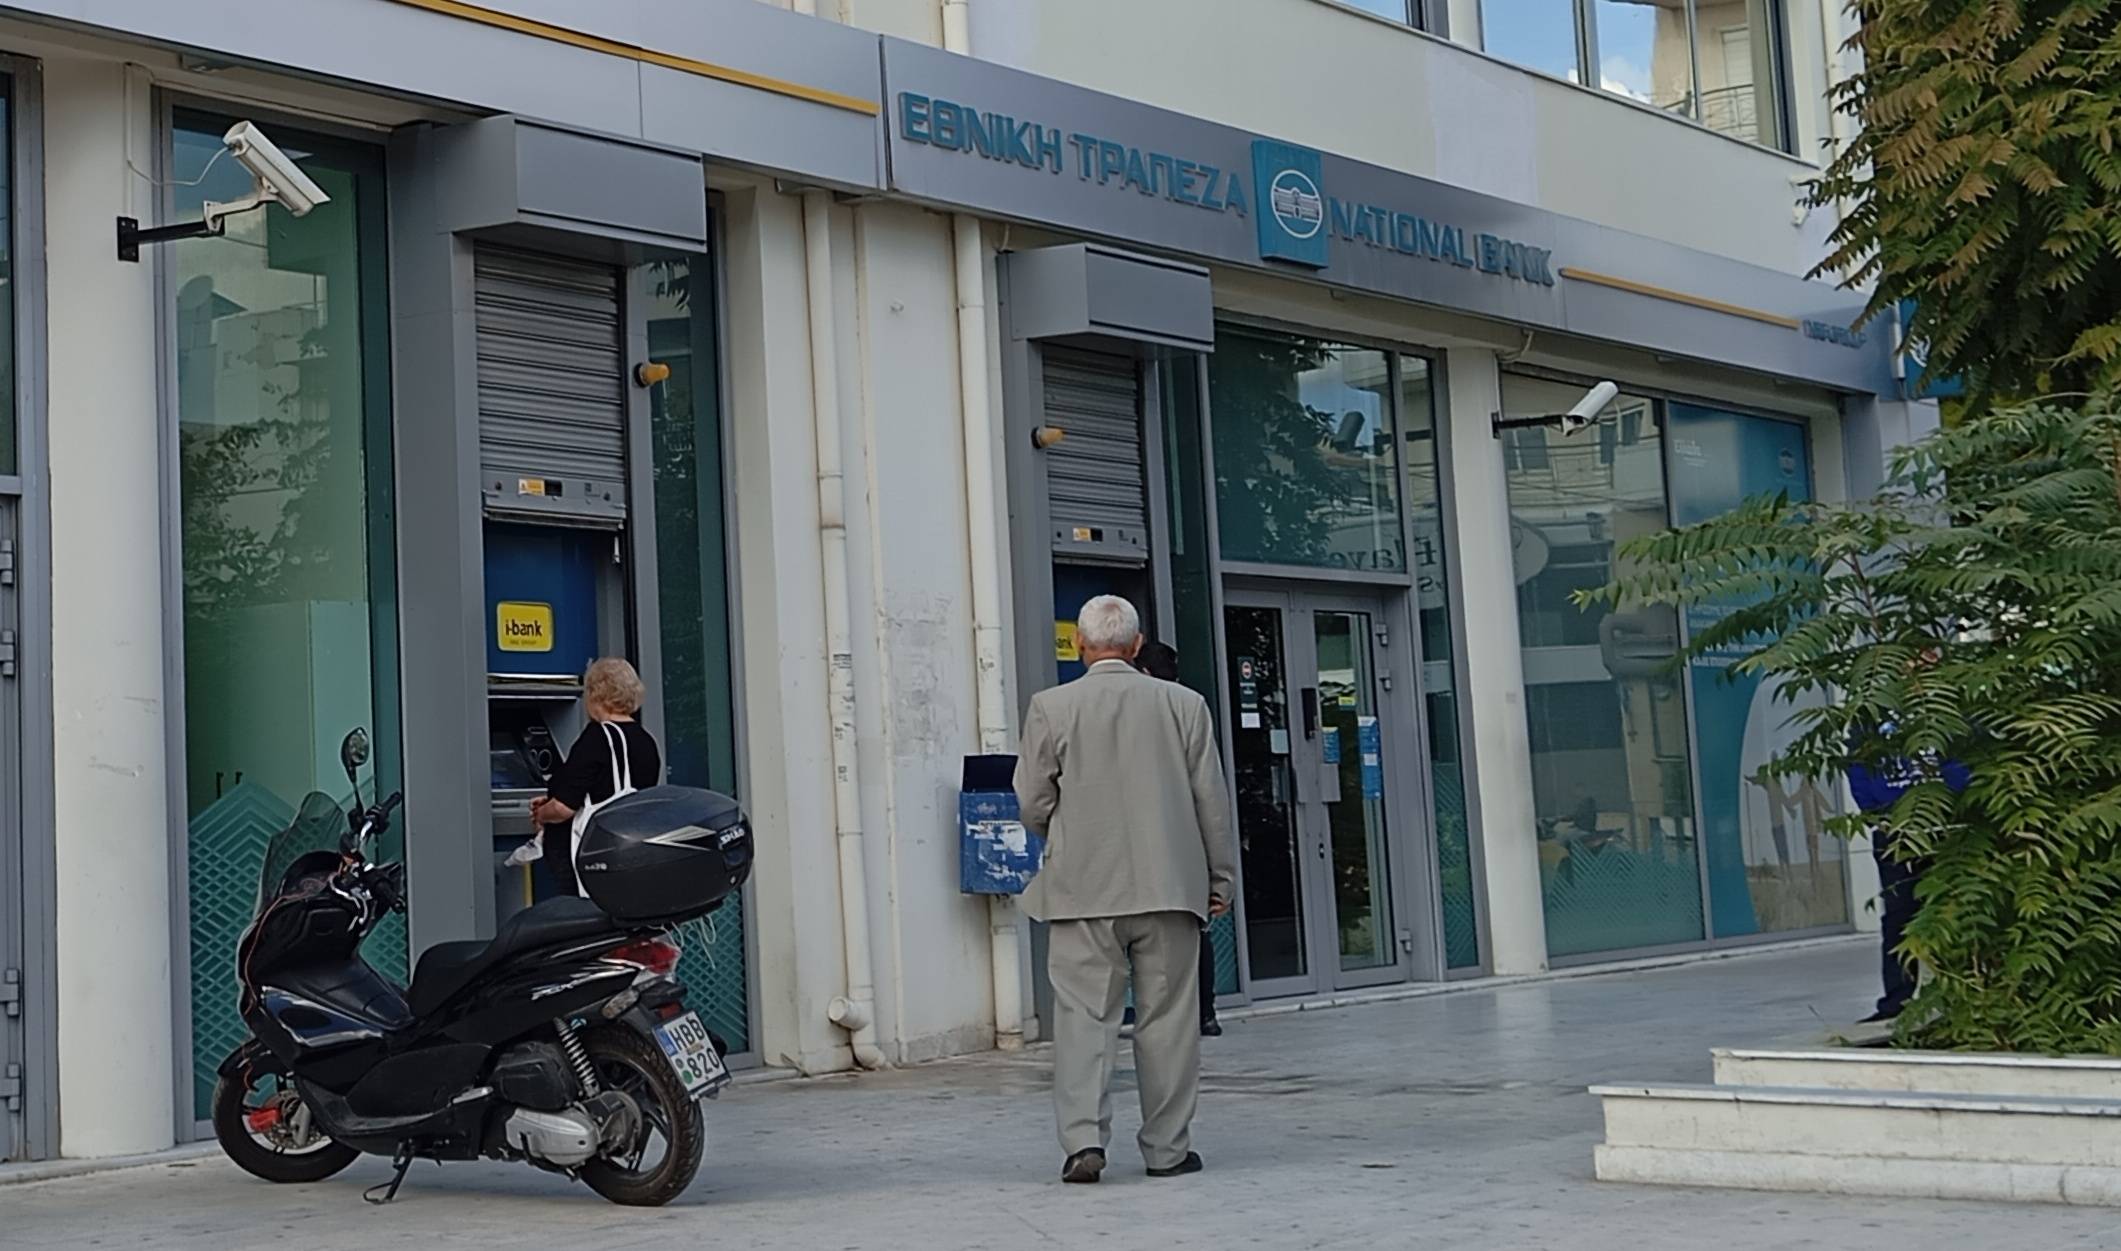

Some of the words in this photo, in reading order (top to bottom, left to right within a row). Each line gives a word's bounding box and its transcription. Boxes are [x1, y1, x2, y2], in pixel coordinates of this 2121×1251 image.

[898, 91, 1063, 175] ΕΘΝΙΚΗ
[1067, 133, 1248, 218] ΤΡΑΠΕΖΑ
[1327, 197, 1474, 269] NATIONAL
[1474, 232, 1554, 287] BANK
[505, 618, 543, 636] i-bank
[668, 1016, 705, 1051] HBB
[686, 1047, 720, 1079] 820
